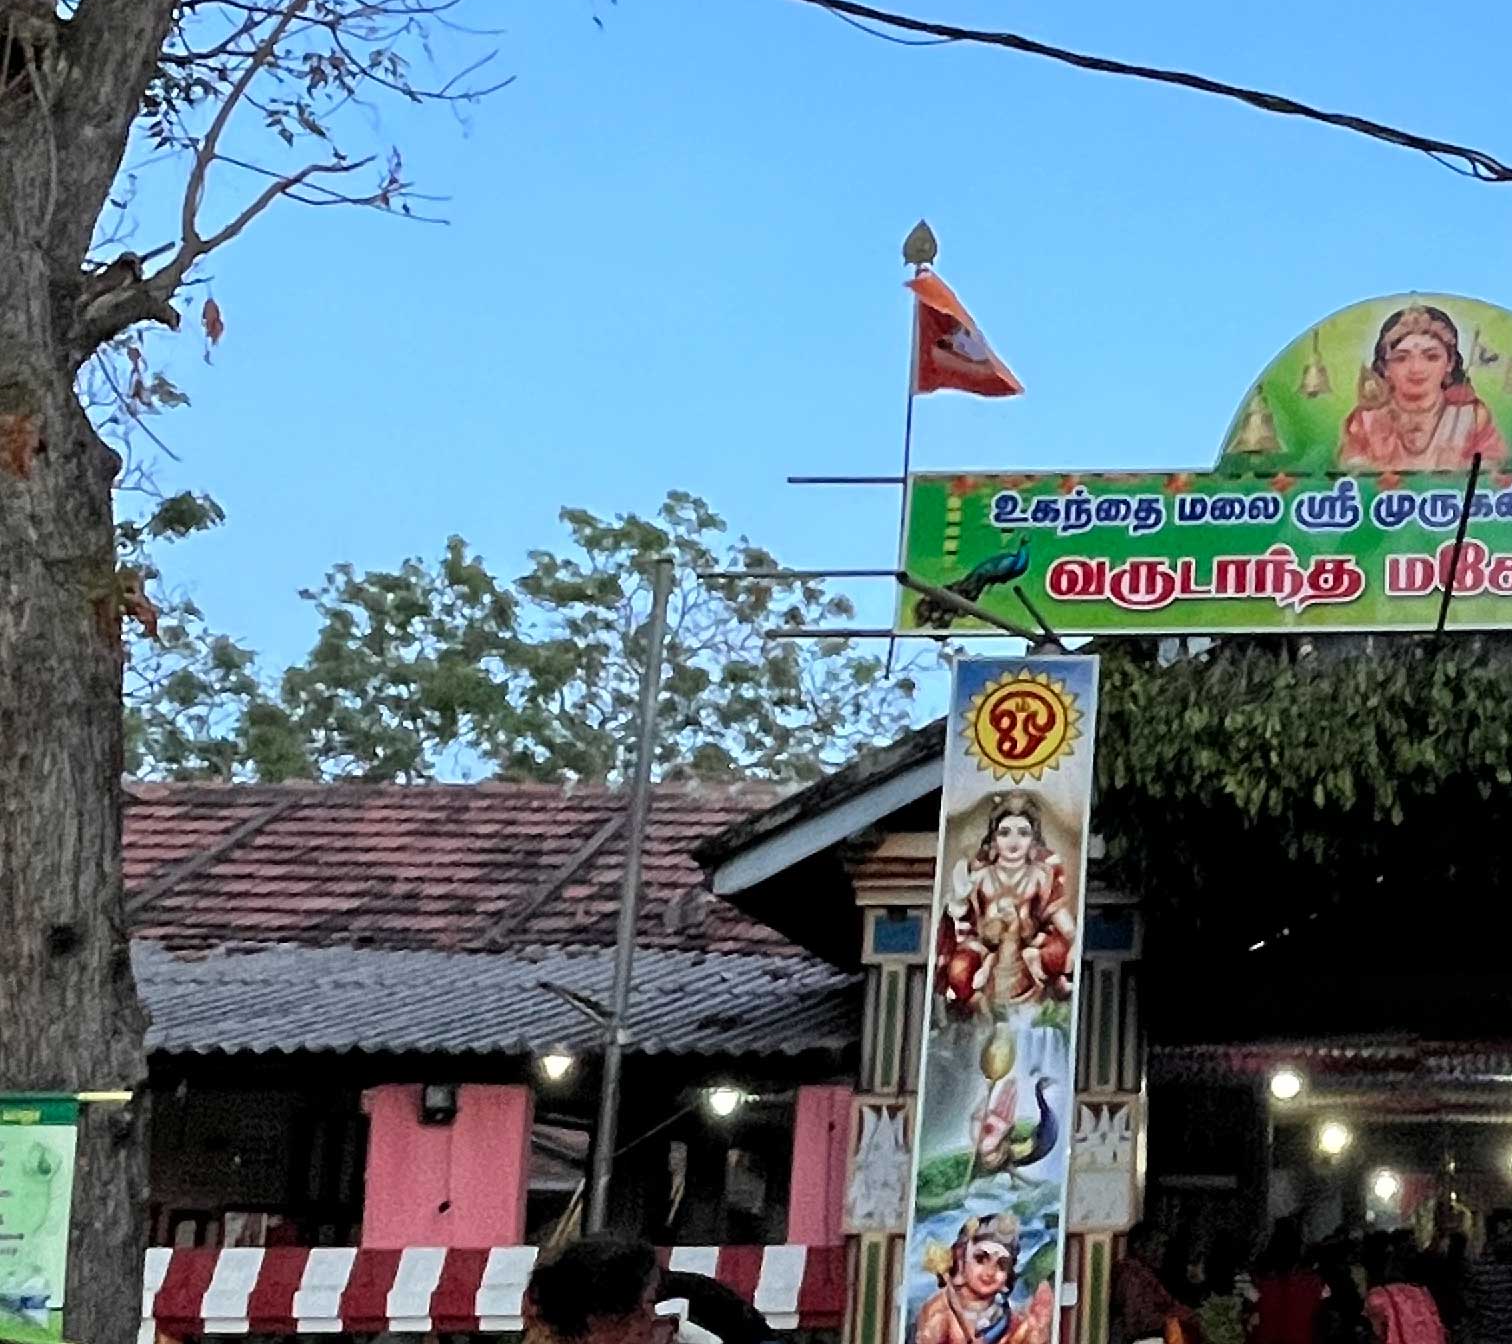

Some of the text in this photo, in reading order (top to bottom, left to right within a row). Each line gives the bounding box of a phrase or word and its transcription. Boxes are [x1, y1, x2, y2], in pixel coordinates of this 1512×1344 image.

[992, 488, 1164, 533] உகந்தை
[1176, 492, 1280, 523] மலை
[1296, 479, 1360, 529] ஸ்ரீ
[1048, 546, 1363, 607] வருடாந்த
